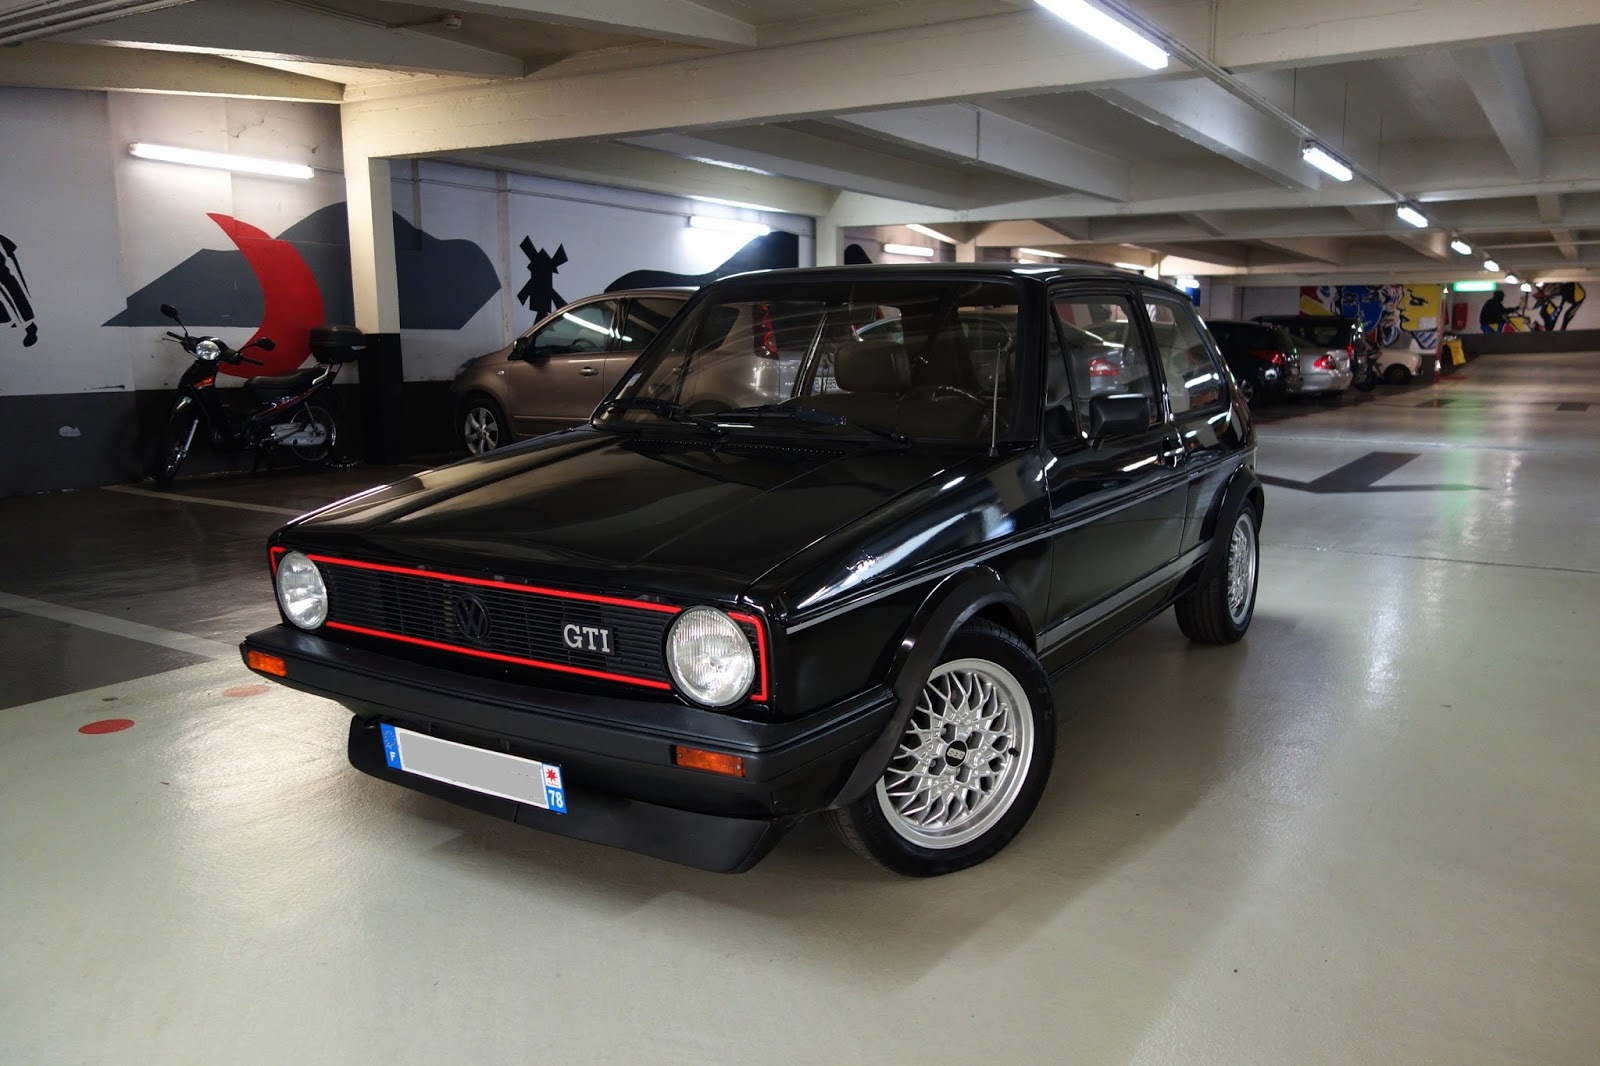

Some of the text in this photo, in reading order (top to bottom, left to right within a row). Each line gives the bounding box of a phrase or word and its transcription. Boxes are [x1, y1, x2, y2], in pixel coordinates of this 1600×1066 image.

[564, 624, 610, 652] GTI
[390, 752, 396, 761] F
[548, 790, 563, 808] 78
